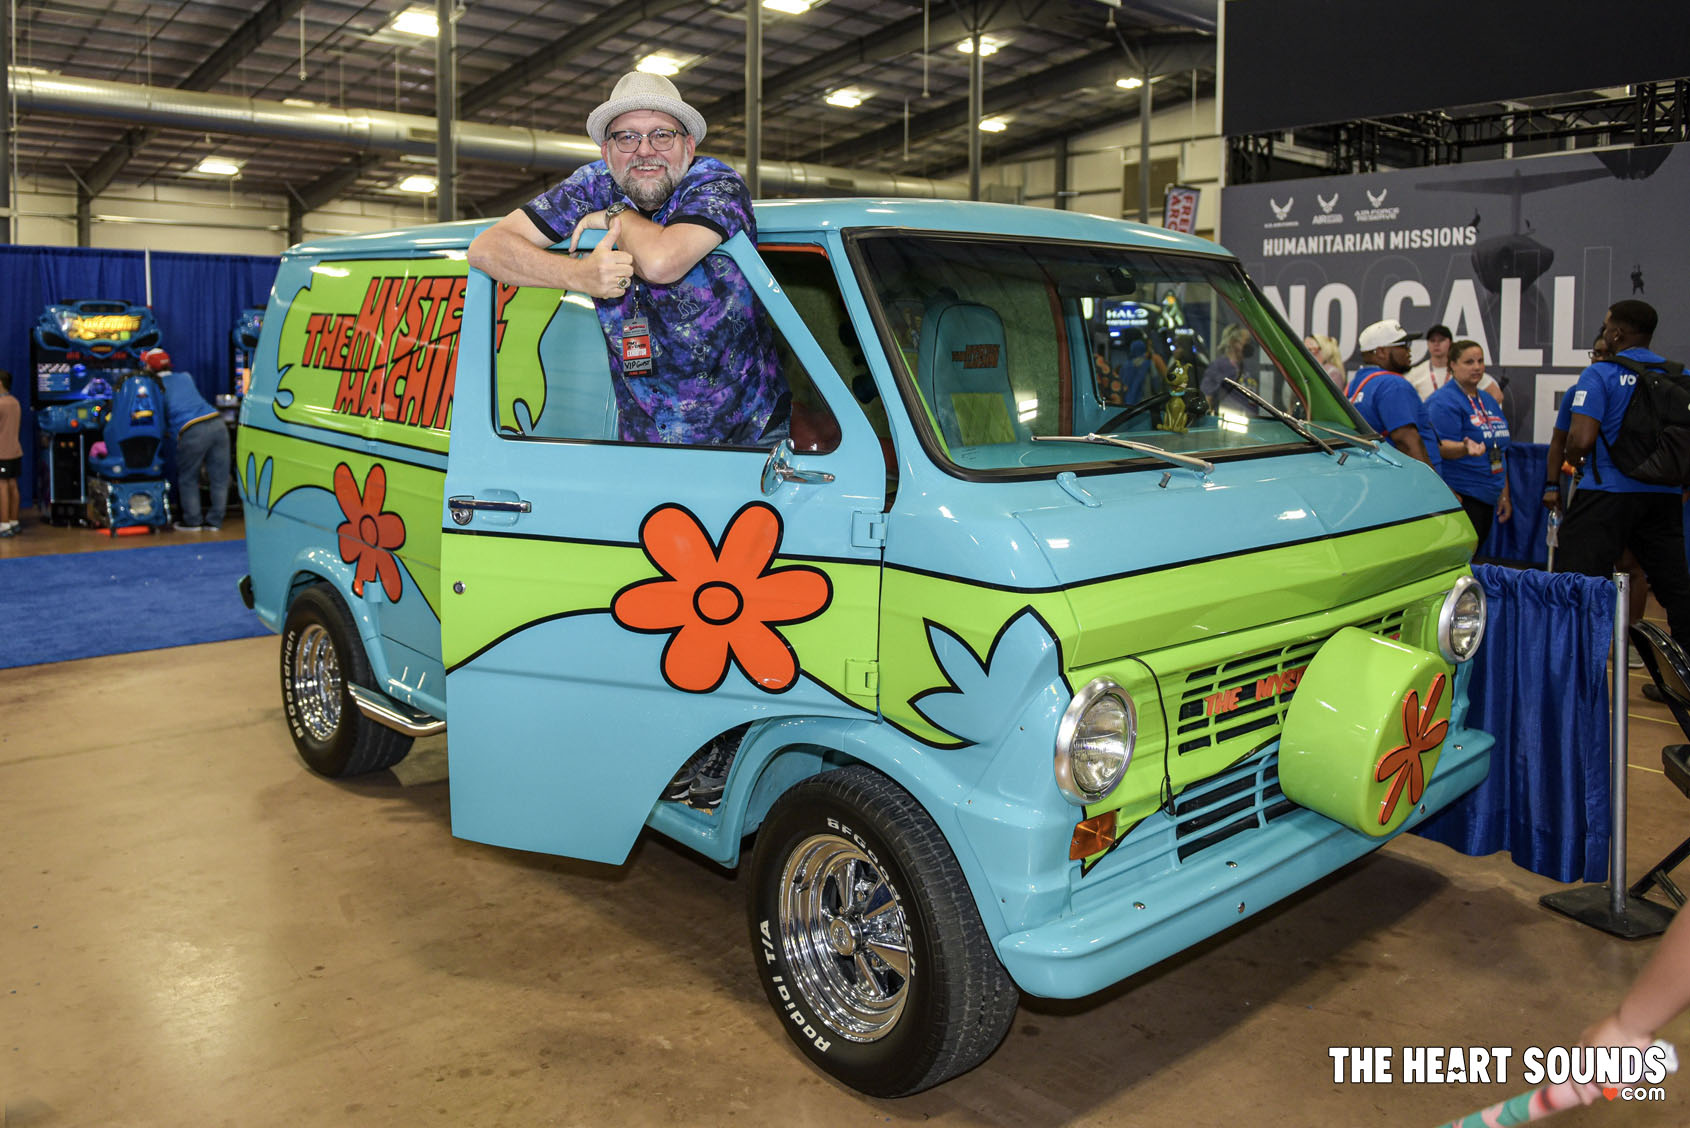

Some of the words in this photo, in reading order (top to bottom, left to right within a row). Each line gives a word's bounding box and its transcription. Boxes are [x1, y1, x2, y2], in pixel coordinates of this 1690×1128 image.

[1179, 194, 1193, 233] FRE
[1263, 232, 1385, 257] HUMANITARIAN
[1390, 226, 1476, 250] MISSIONS
[1106, 308, 1149, 319] HALO
[1382, 275, 1594, 367] CALL
[301, 312, 358, 369] THE
[1204, 687, 1243, 717] THE
[759, 919, 776, 965] T/A
[772, 975, 832, 1052] Radial
